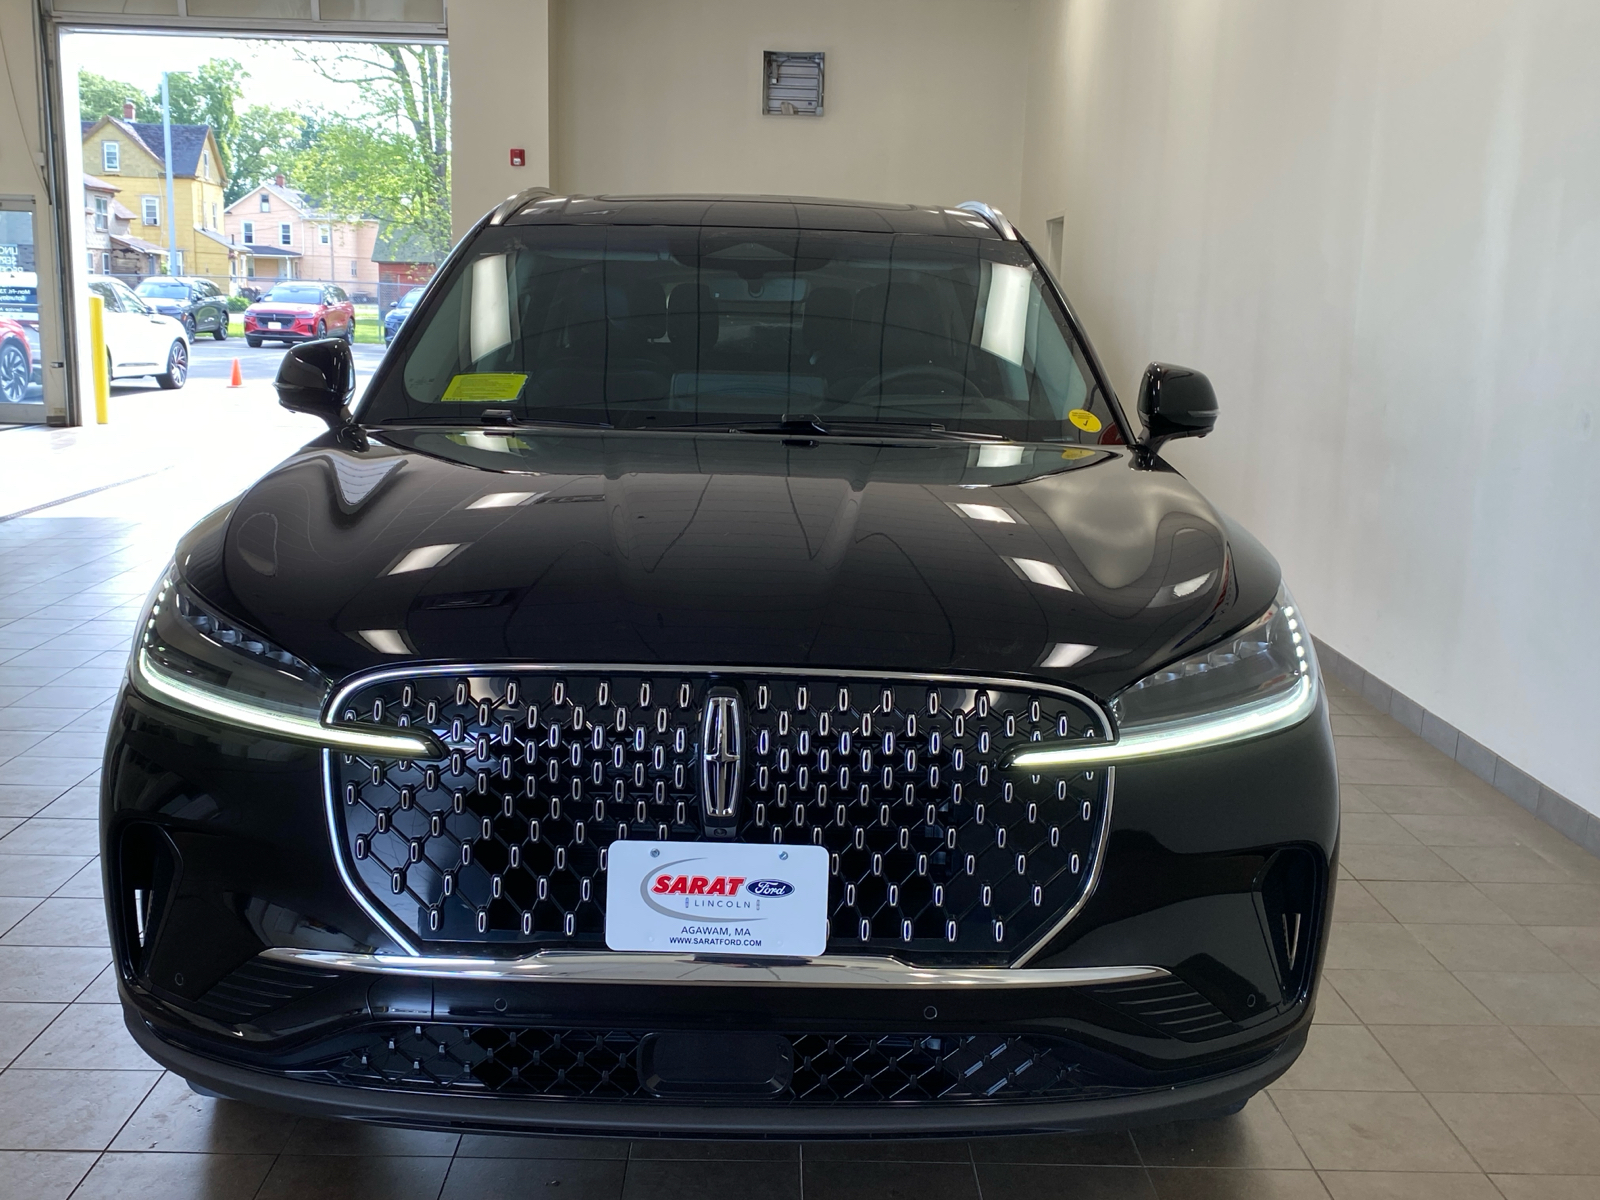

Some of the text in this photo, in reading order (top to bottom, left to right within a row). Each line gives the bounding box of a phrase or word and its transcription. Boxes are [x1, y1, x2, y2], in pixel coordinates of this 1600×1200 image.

[651, 874, 787, 897] SARAT Ford
[694, 899, 751, 909] LINCOLN
[681, 926, 752, 937] AGAWAM, MA
[669, 936, 762, 947] WWW.SARATFORD.COM
